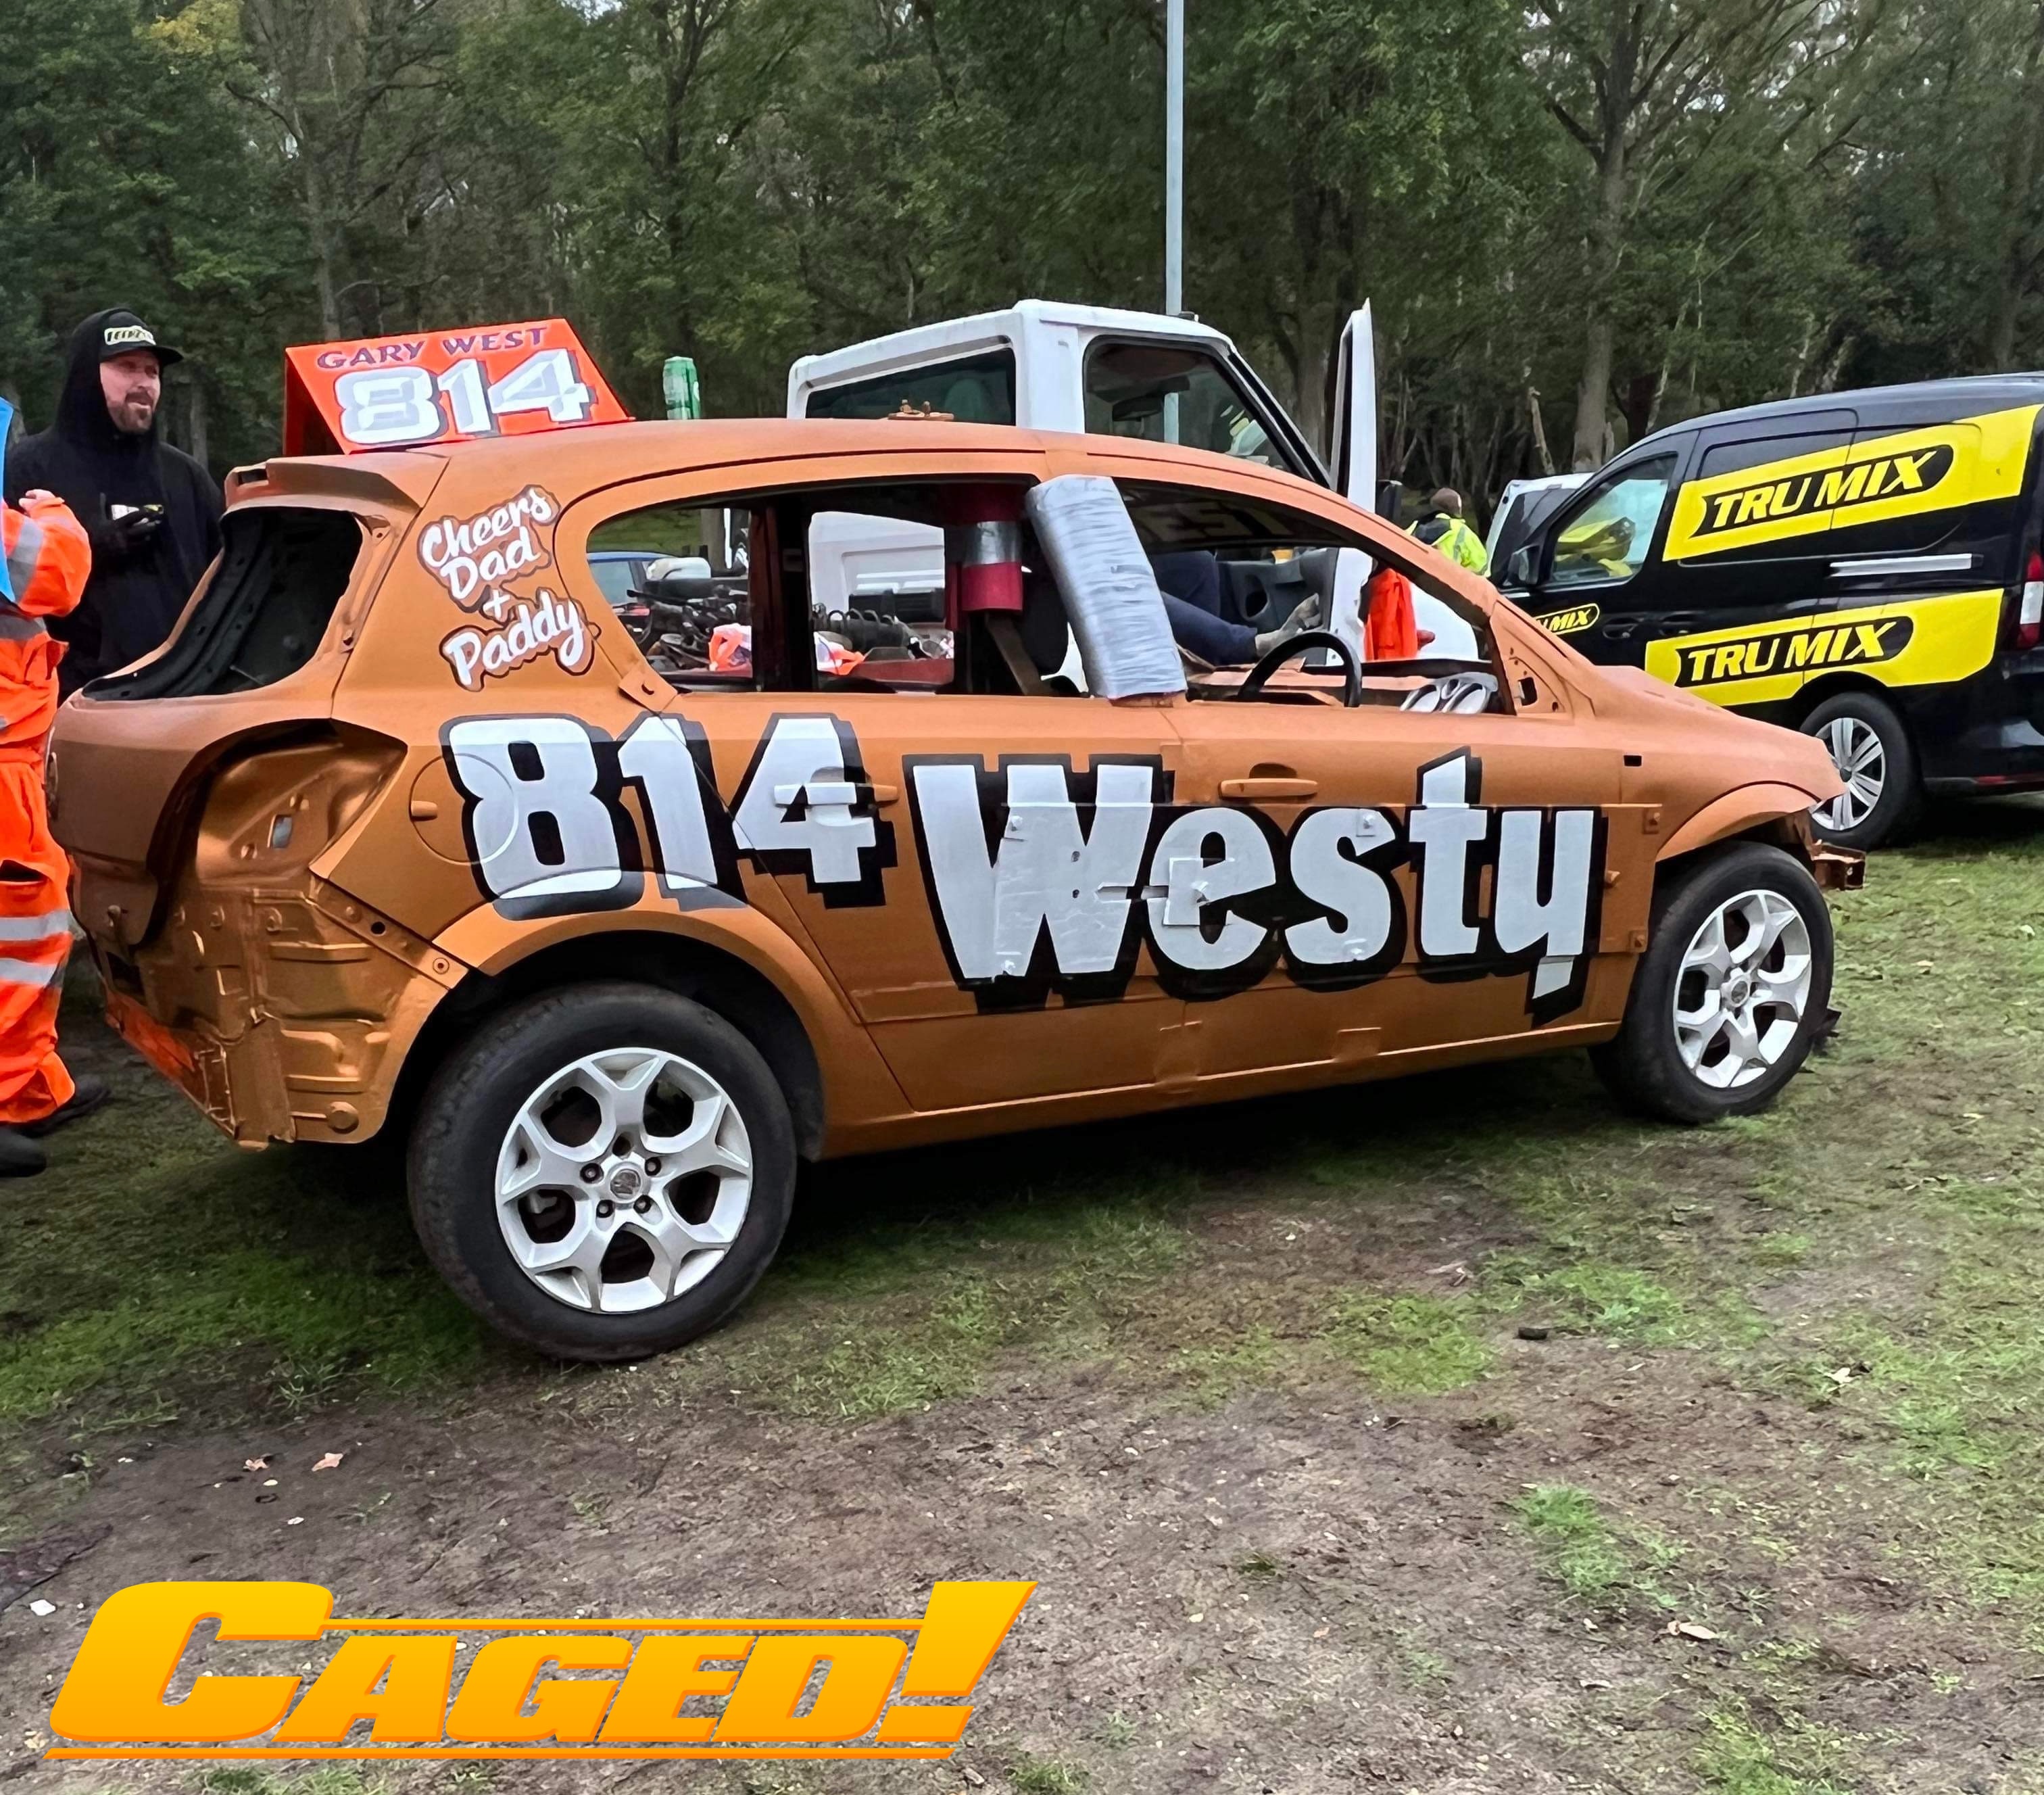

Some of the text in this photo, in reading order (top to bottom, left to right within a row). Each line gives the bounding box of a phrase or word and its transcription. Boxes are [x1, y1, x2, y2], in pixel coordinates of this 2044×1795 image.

[317, 327, 547, 369] GARY WEST
[335, 348, 595, 444] 814
[422, 487, 552, 567] Cheers
[440, 526, 541, 600] Dad
[443, 590, 584, 686] Paddy
[446, 715, 1594, 999] 814 Westy
